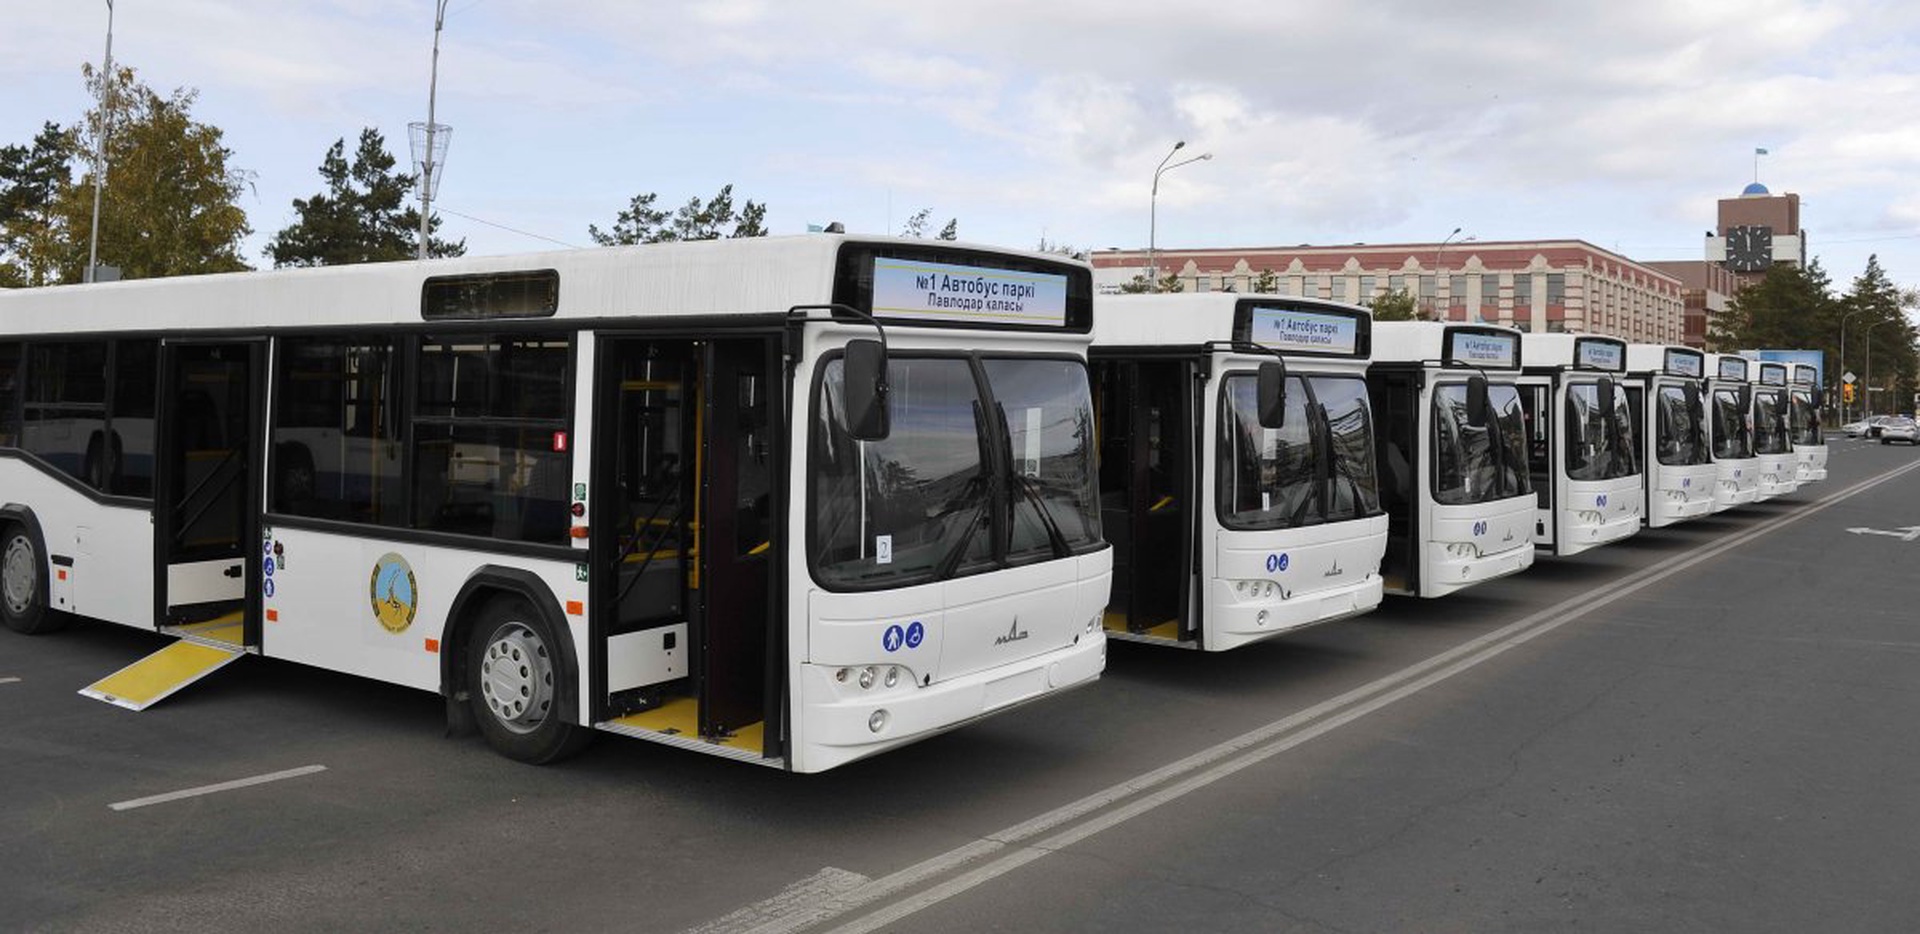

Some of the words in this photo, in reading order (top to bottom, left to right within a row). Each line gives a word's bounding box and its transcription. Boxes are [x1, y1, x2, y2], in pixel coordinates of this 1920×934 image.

[916, 273, 936, 290] №1
[941, 274, 999, 298] Автобус
[928, 292, 983, 311] Павлодар
